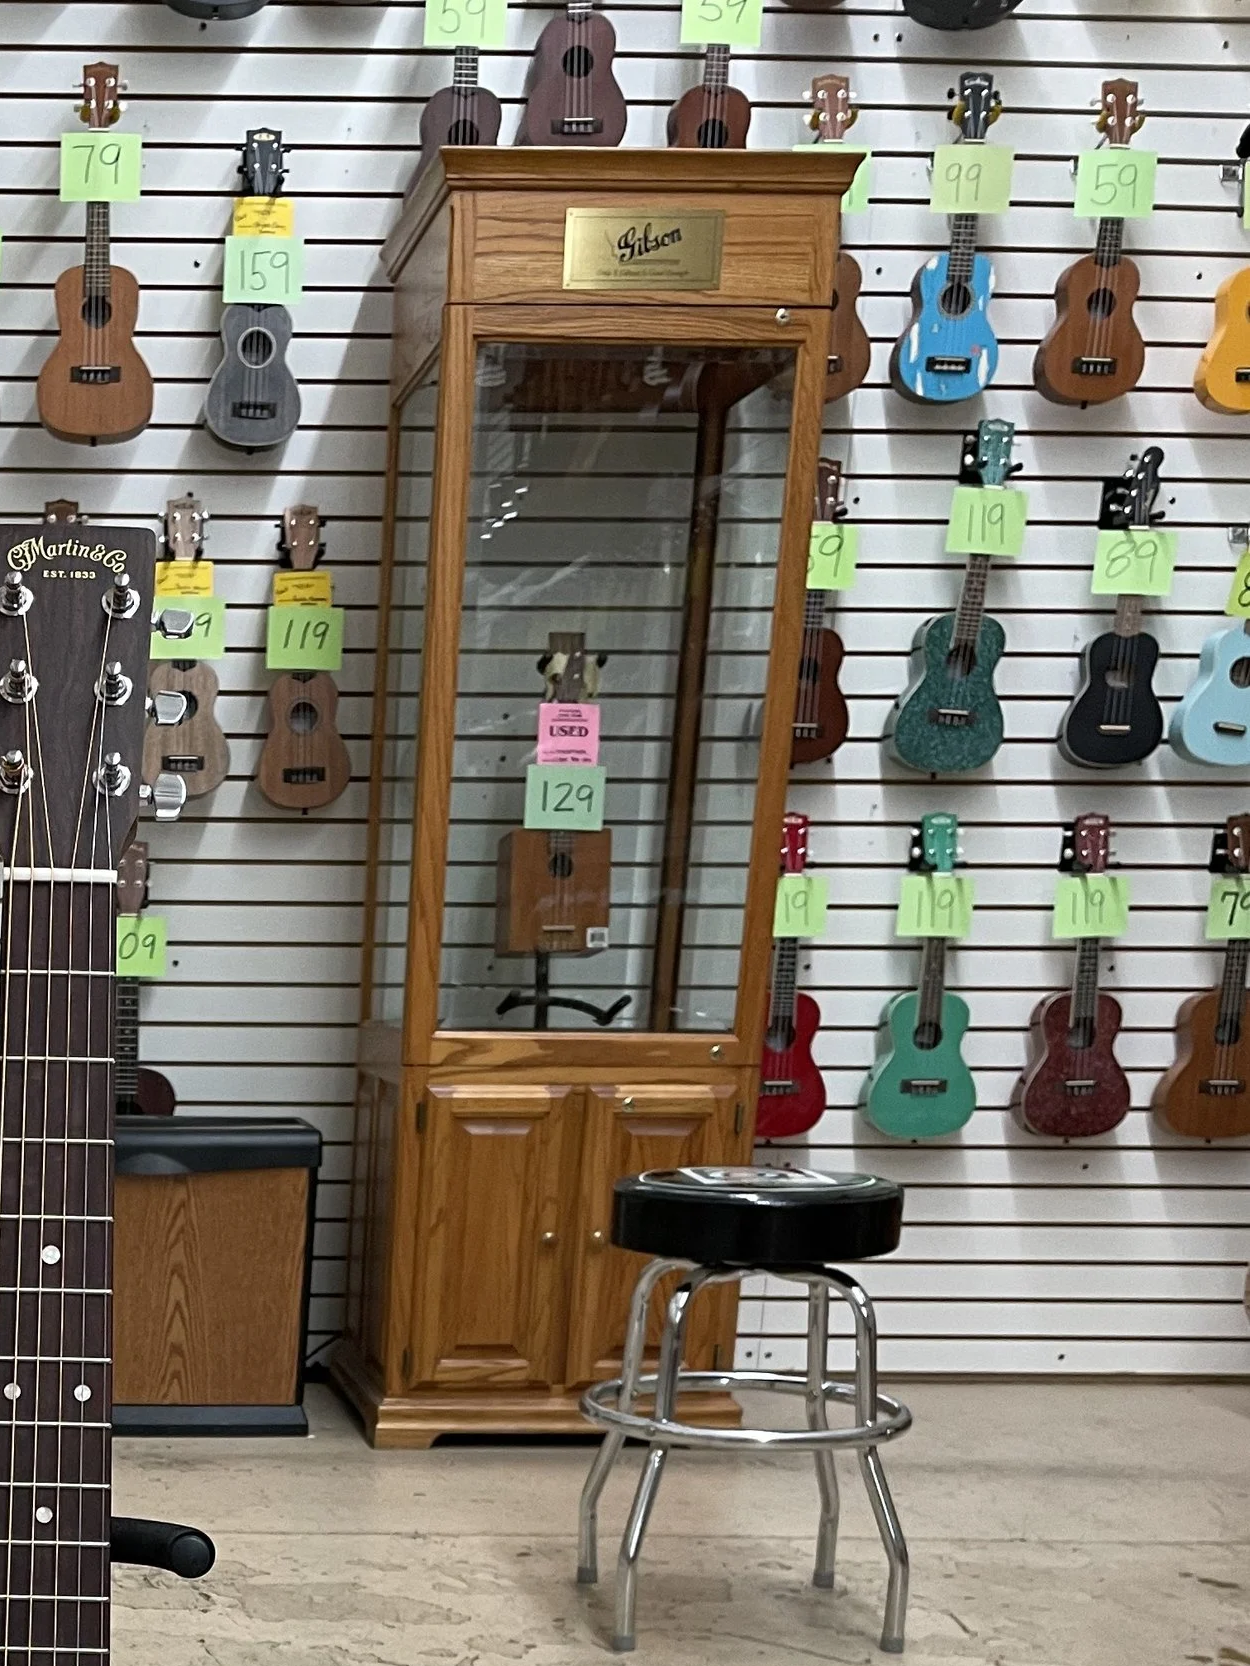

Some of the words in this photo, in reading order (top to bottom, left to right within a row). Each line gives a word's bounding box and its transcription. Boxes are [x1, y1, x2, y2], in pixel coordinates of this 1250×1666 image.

[72, 143, 122, 184] 79
[945, 162, 983, 203] 99
[1090, 163, 1138, 208] 59
[617, 222, 683, 262] Gibson
[240, 250, 290, 294] 159
[967, 502, 1005, 545] 119
[42, 569, 67, 579] EST.
[70, 570, 96, 580] 1833
[1105, 539, 1159, 584] 89
[283, 619, 330, 650] 119
[549, 725, 590, 738] USED
[541, 780, 594, 813] 129
[783, 890, 809, 928] 19
[915, 888, 956, 930] 119
[1071, 889, 1106, 926] 119
[117, 931, 157, 961] 09
